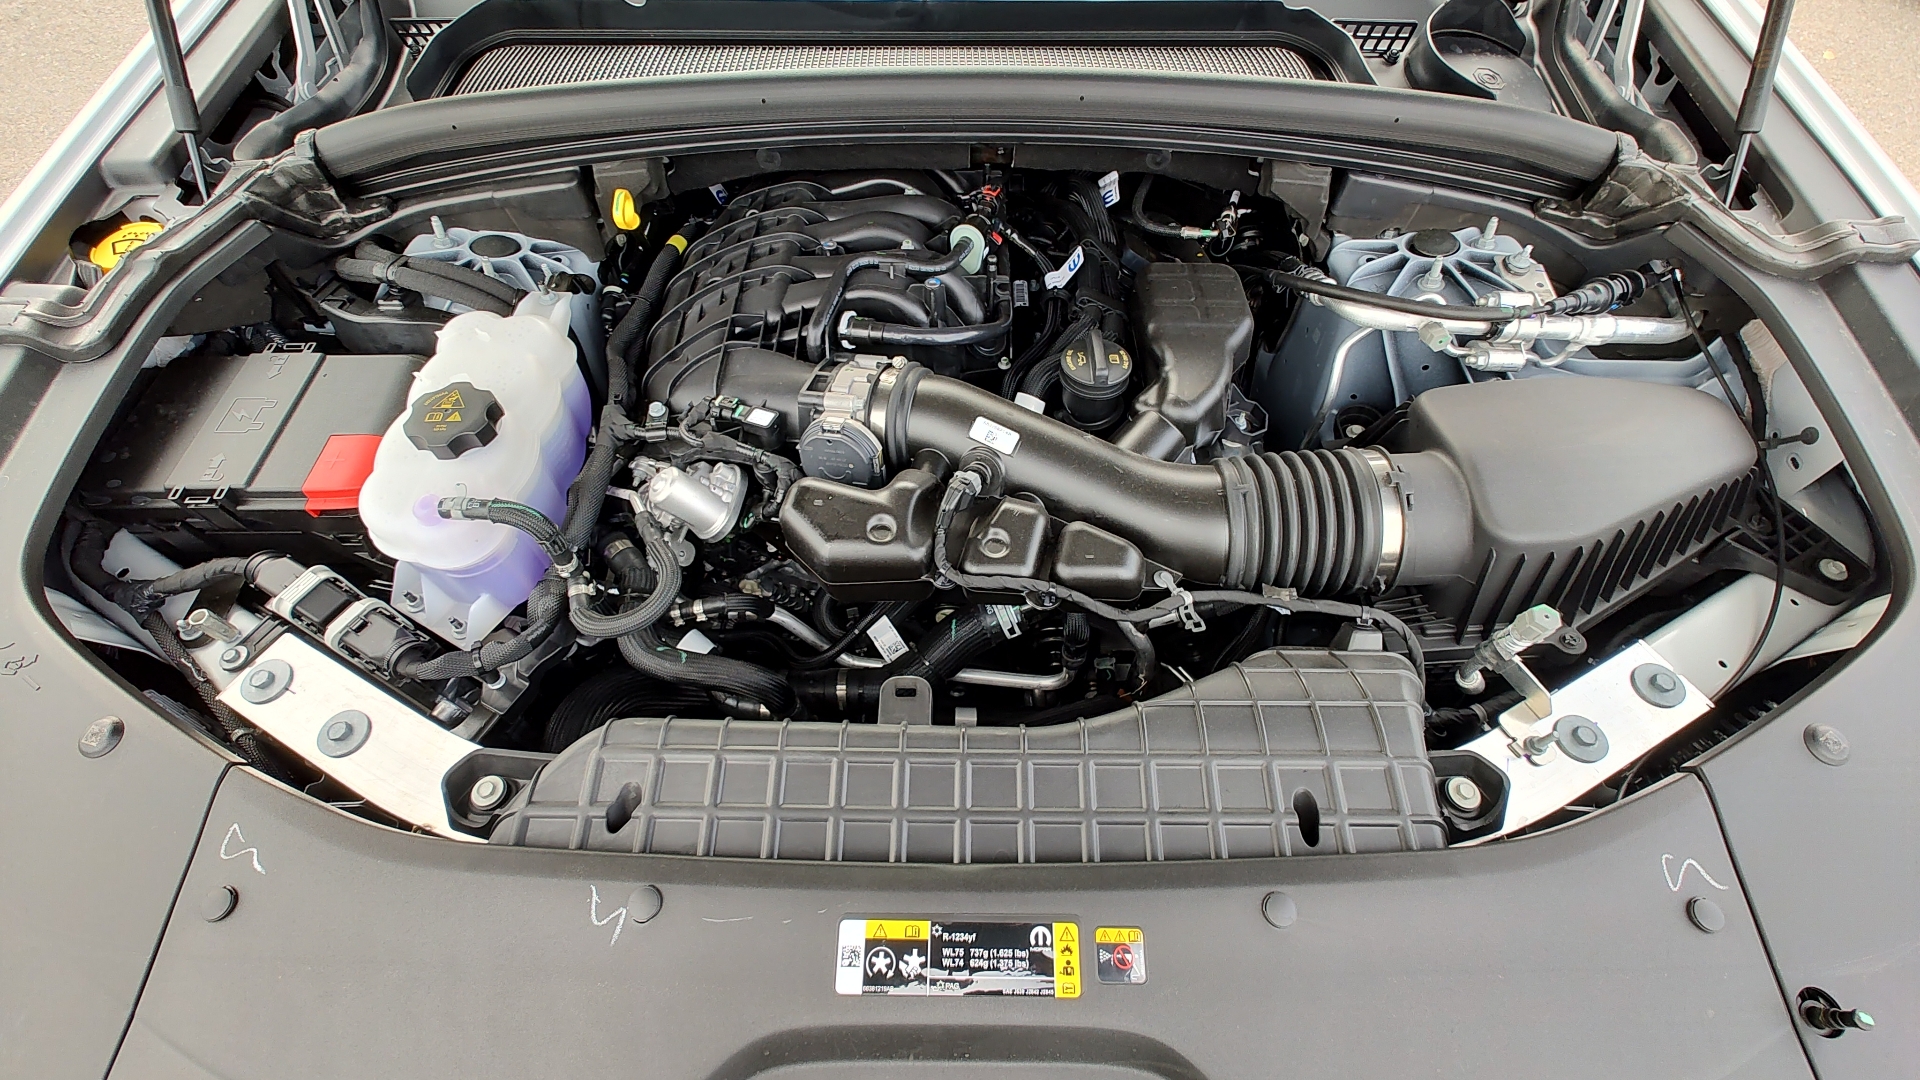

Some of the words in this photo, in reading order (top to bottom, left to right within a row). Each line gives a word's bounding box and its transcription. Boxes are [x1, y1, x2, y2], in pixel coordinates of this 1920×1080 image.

[942, 932, 977, 944] R-1234yf
[942, 948, 964, 957] WL75
[969, 948, 989, 959] 737g
[989, 948, 1013, 959] (1.625
[1014, 948, 1029, 959] lbs)
[942, 958, 964, 967] WL74
[969, 959, 989, 969] 624g
[989, 959, 1014, 970] (1.375
[1014, 959, 1029, 970] lbs)
[945, 982, 960, 990] PAG
